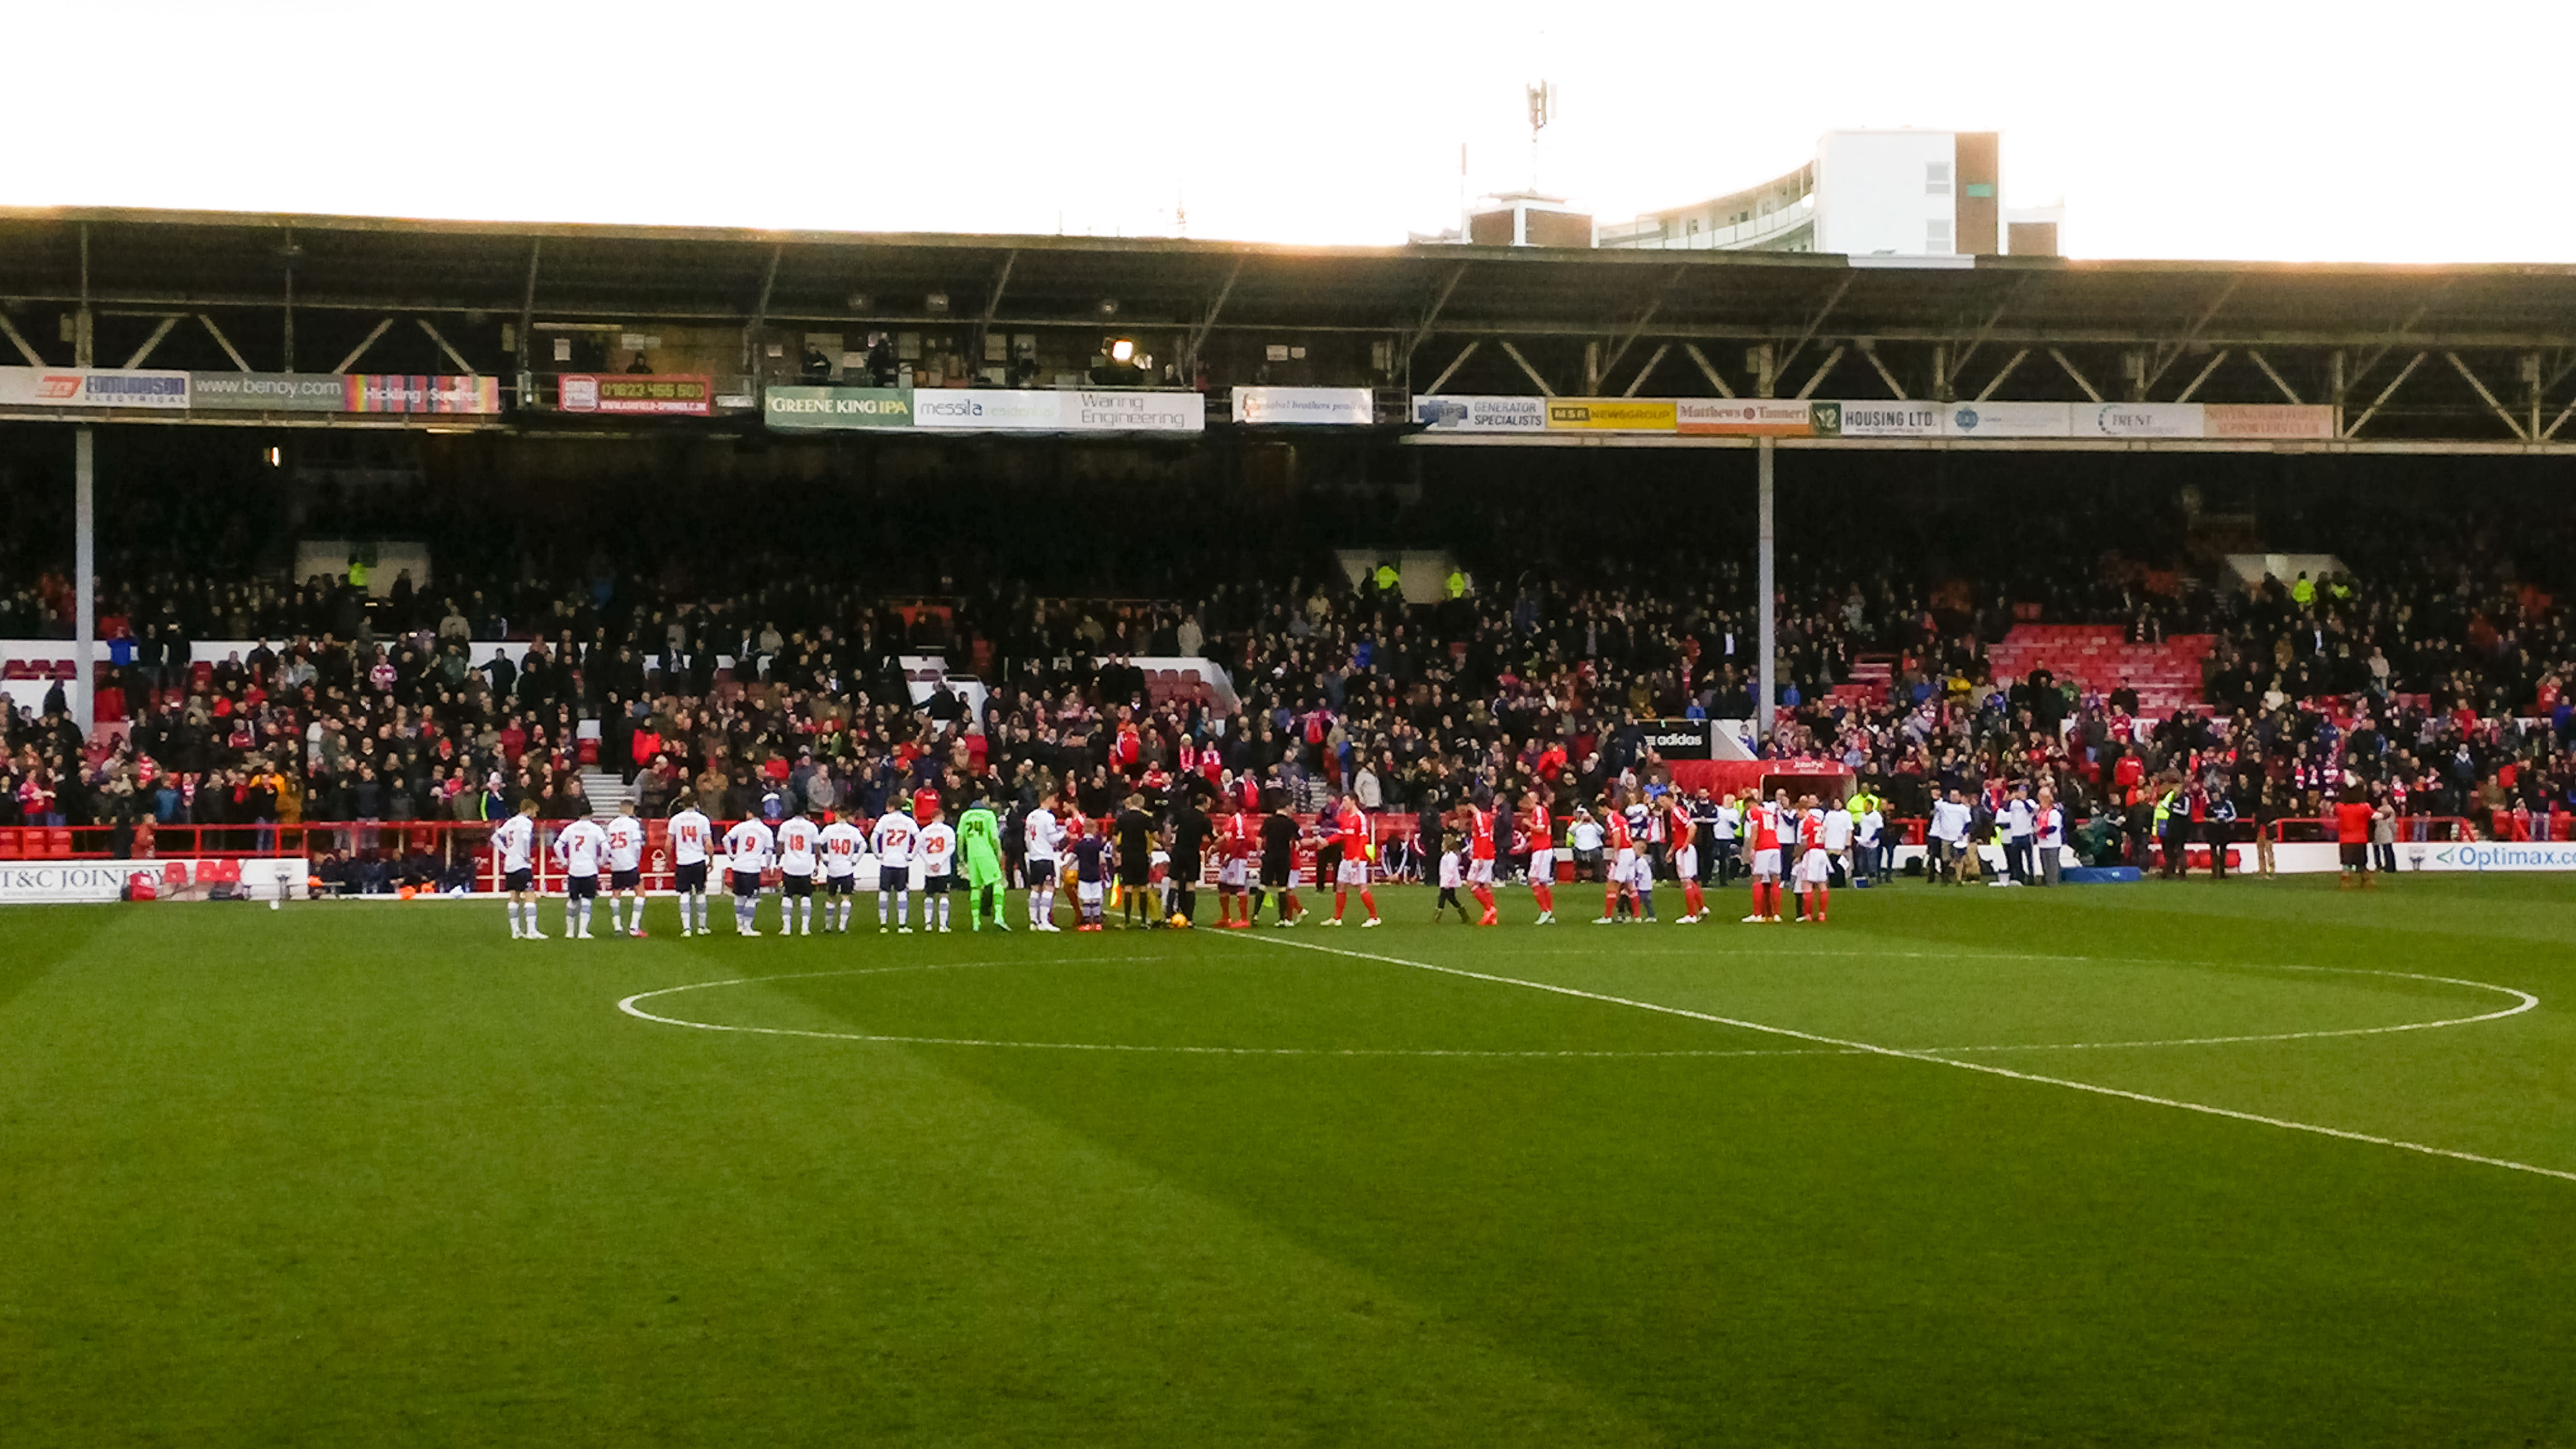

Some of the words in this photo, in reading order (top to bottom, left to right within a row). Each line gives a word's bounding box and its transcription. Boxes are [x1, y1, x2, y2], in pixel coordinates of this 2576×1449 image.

[195, 378, 341, 398] www.benoy.com
[364, 387, 420, 403] Hickling
[85, 394, 186, 403] ELECTRICAL
[773, 397, 834, 413] GREENE
[836, 400, 877, 414] KING
[879, 400, 908, 415] IPA
[1292, 401, 1329, 411] brothers
[921, 399, 982, 416] messila
[1474, 402, 1536, 412] GENERATOR
[1680, 405, 1741, 418] Matthews
[1081, 410, 1185, 427] Engineering
[1474, 415, 1542, 426] SPECIALISTS
[1592, 410, 1669, 420] NEWSGROUP
[1846, 411, 1904, 426] HOUSING
[2113, 414, 2152, 426] TRENT
[1656, 733, 1702, 747] adidas
[610, 831, 627, 849] 25
[682, 825, 698, 843] 14
[745, 837, 756, 852] 9
[1, 869, 53, 888] T&C
[61, 869, 165, 889] JOINY
